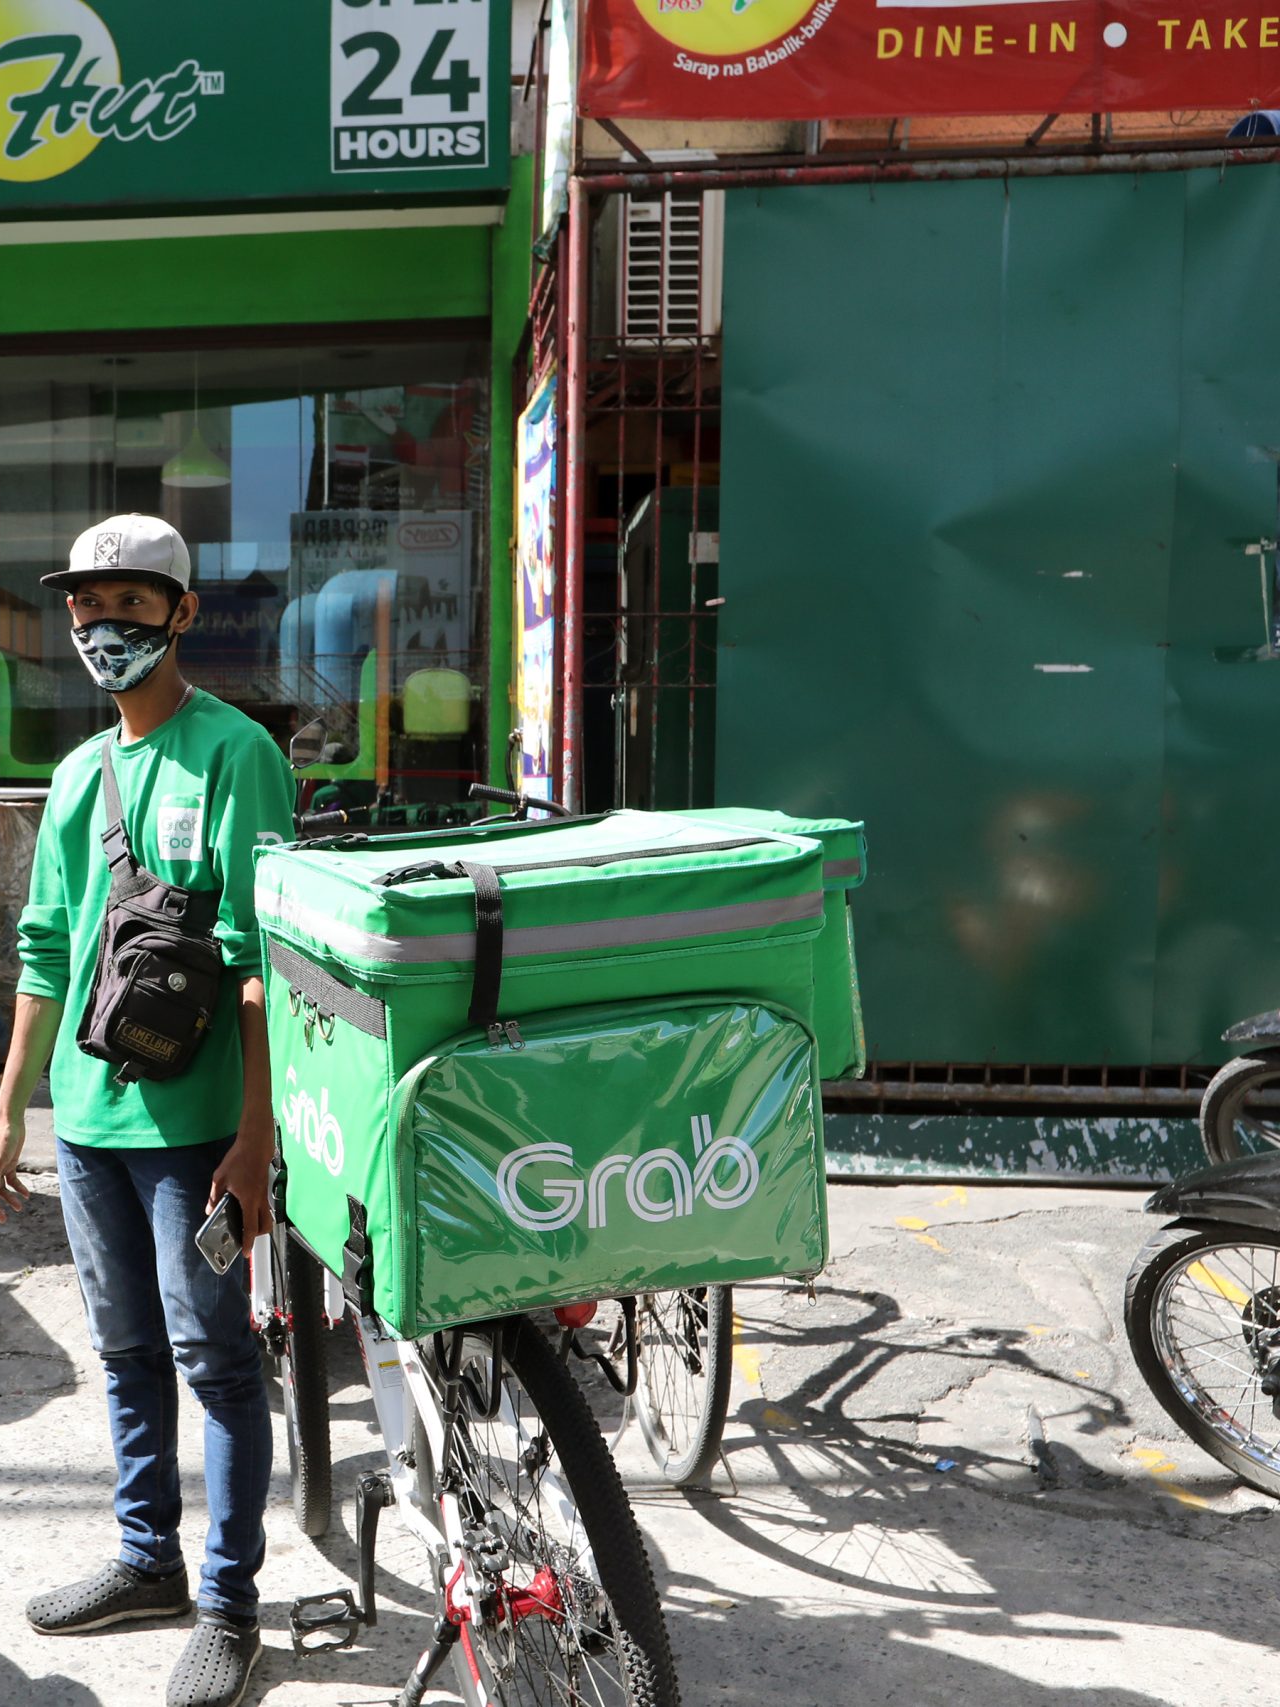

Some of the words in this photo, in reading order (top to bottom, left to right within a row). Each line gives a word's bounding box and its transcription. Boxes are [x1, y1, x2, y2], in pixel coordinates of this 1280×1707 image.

[340, 28, 481, 117] 24
[673, 52, 720, 80] Sarap
[723, 62, 744, 76] na
[746, 0, 839, 73] Babalik-balik
[876, 21, 1077, 59] DINE-IN
[1157, 17, 1280, 50] TAKE
[339, 125, 482, 161] HOURS
[122, 1024, 176, 1057] CAMELBAK
[282, 1064, 345, 1177] Grab
[496, 1113, 760, 1232] Grab
